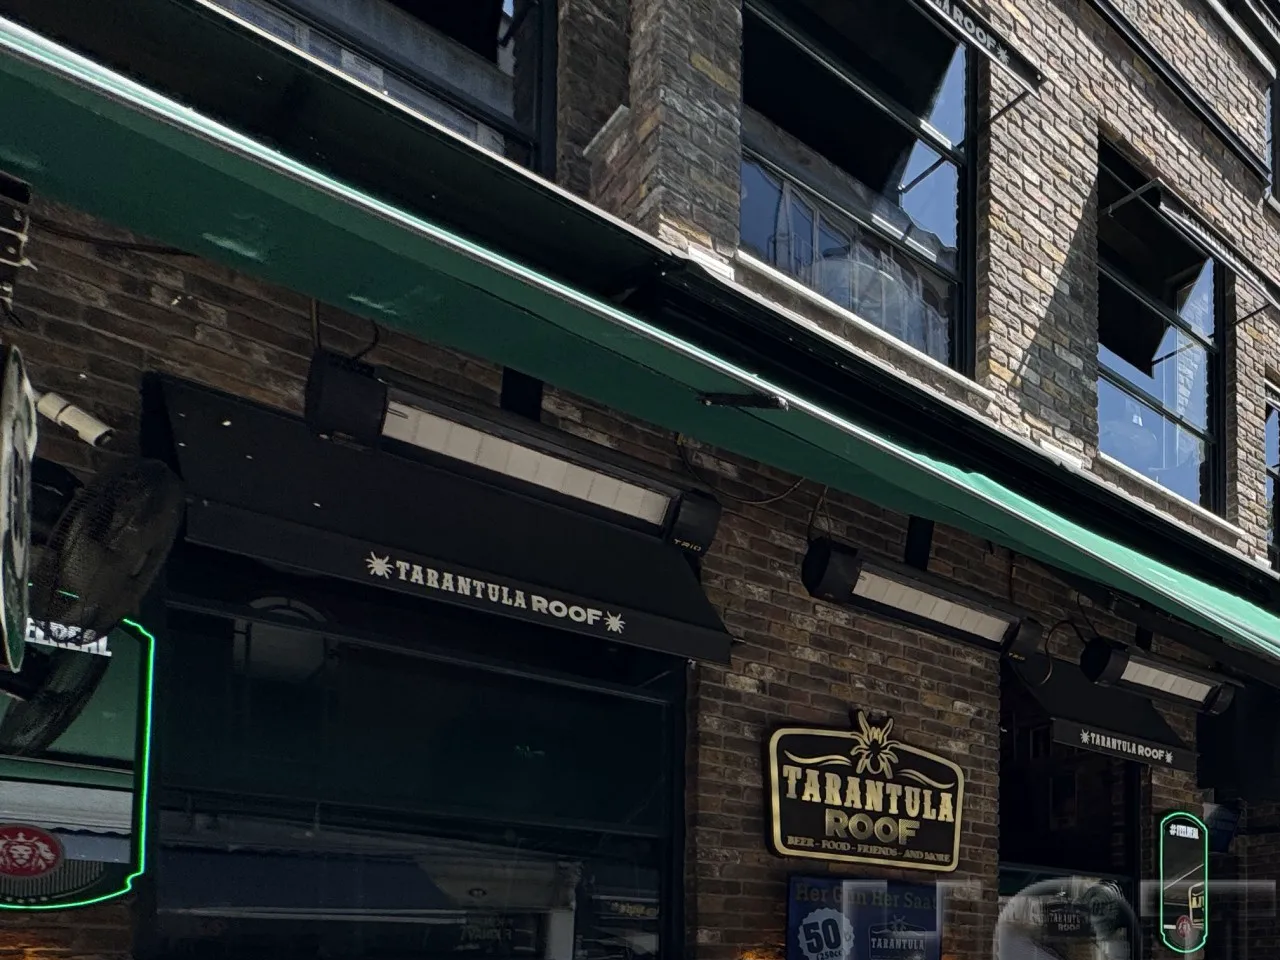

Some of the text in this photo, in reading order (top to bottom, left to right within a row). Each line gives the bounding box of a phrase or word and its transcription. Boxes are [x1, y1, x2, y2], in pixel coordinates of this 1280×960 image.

[953, 5, 997, 50] ROOF
[673, 538, 702, 552] TRIO
[395, 560, 603, 626] TARANTULA ROOF
[1090, 731, 1165, 760] TARANTULA ROOF
[782, 764, 955, 823] TARANTULA
[825, 808, 920, 845] ROOF
[787, 835, 951, 863] BEER FOOD FRIENDS AND MORE
[795, 882, 827, 903] Her
[870, 887, 900, 908] Her
[871, 937, 925, 951] TARANTULA
